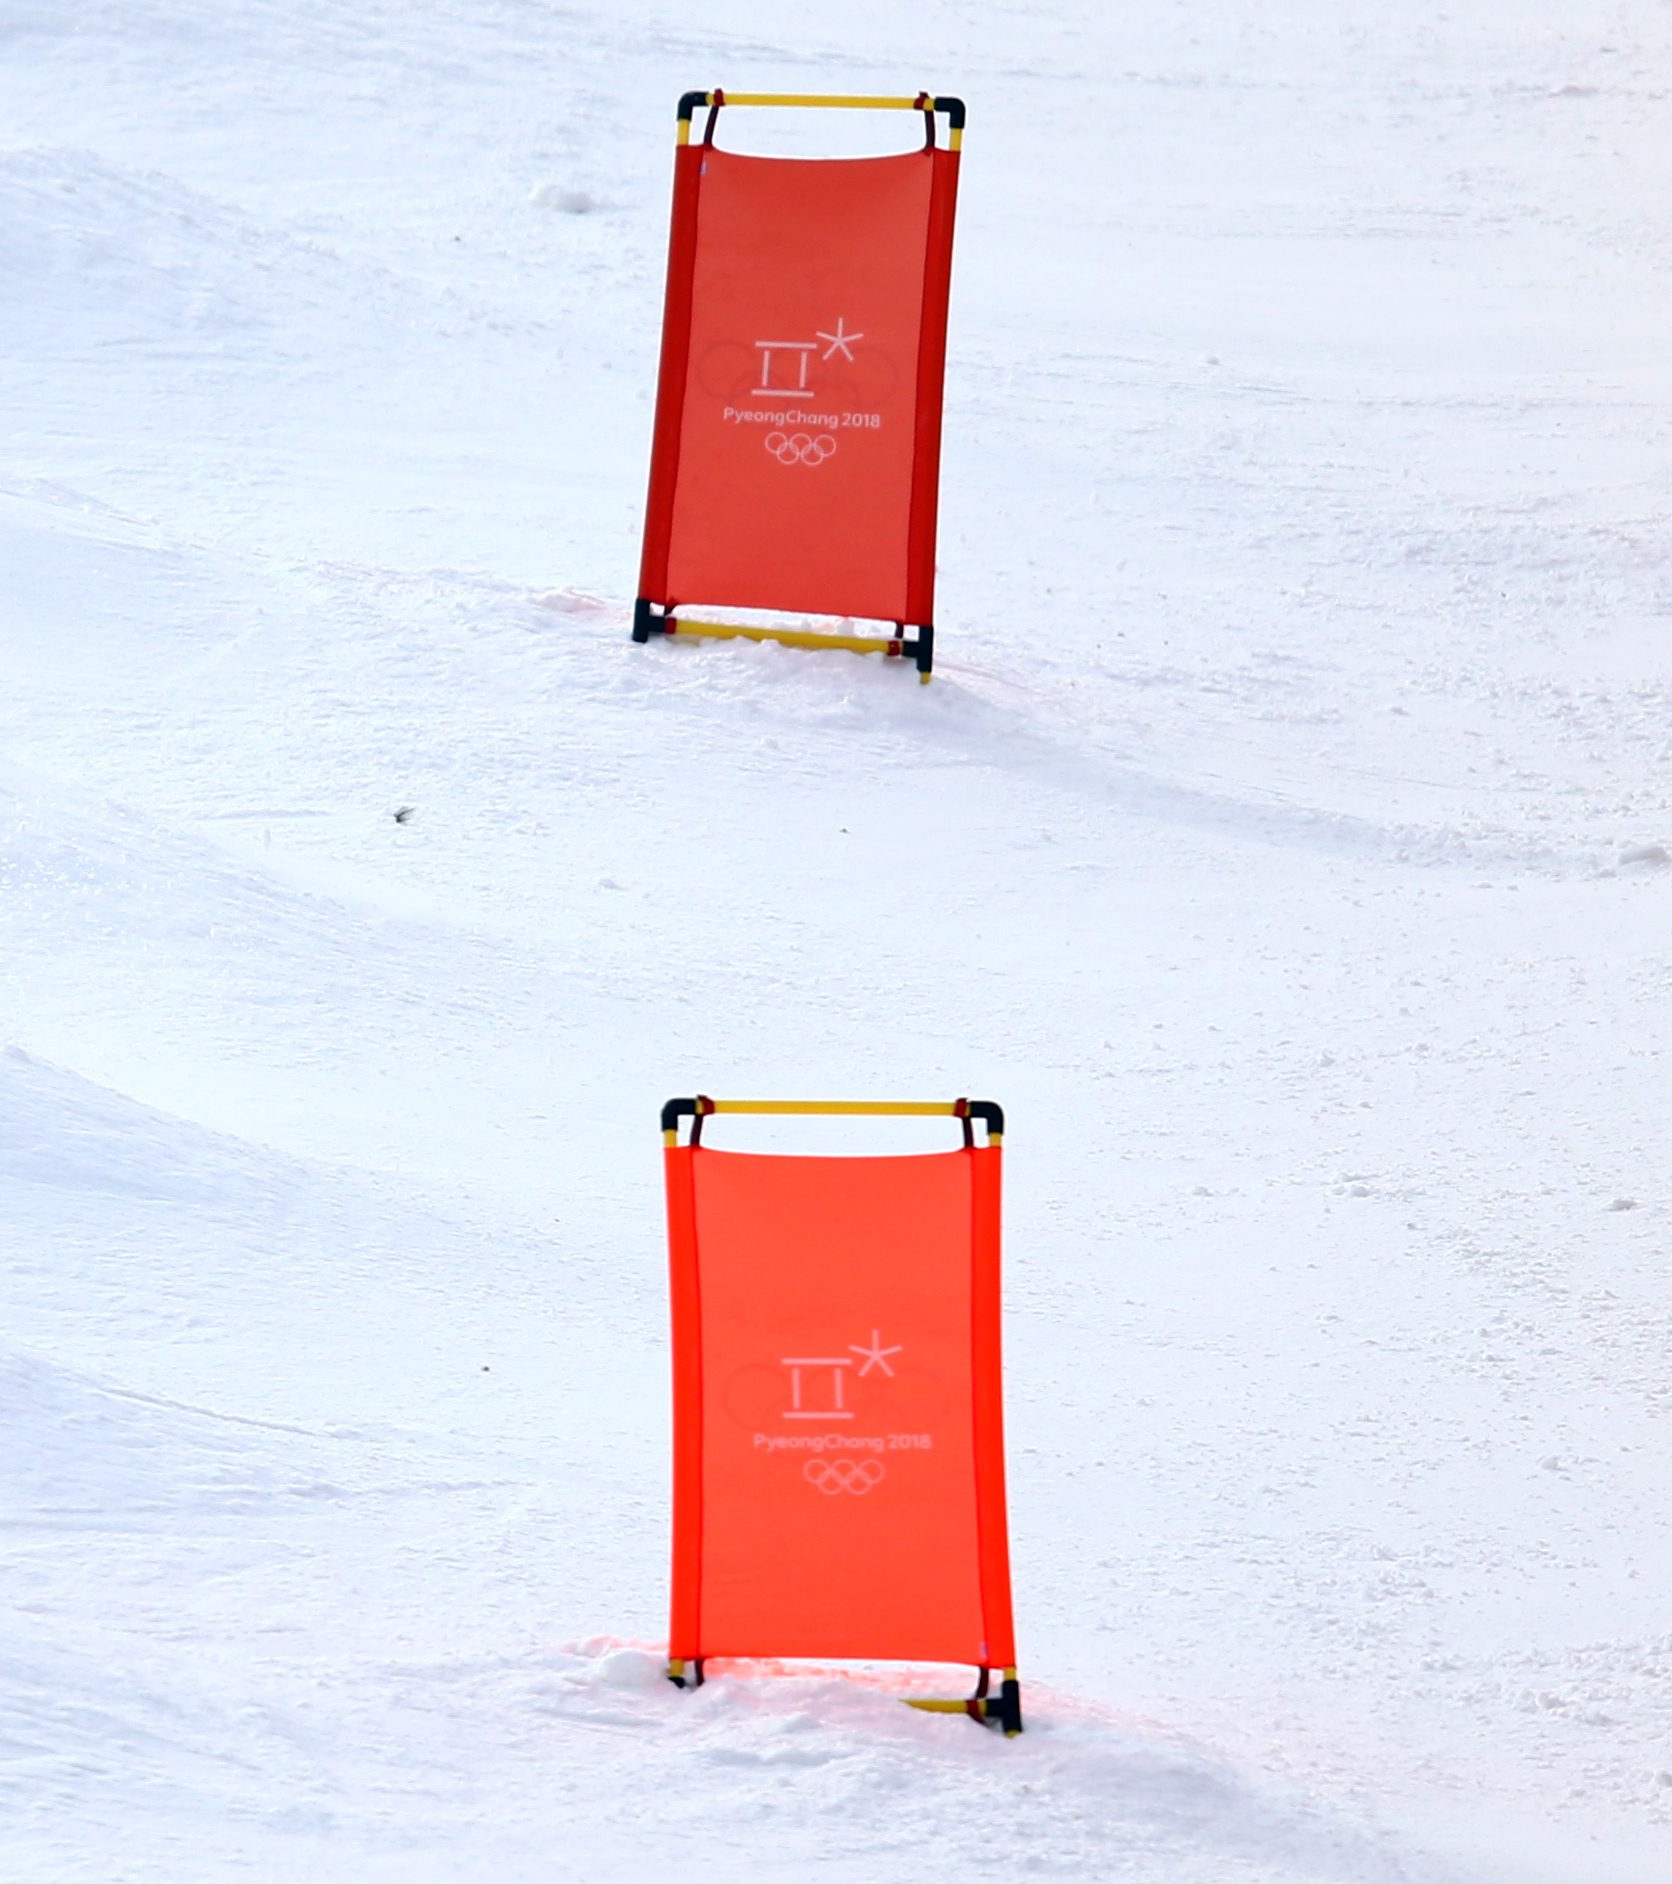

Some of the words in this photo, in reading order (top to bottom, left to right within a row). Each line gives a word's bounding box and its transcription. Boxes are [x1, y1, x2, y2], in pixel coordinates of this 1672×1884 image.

[723, 407, 839, 429] PyeongChang
[842, 412, 881, 428] 2018
[753, 1433, 884, 1453] PyeongChang
[888, 1433, 932, 1450] 2018
